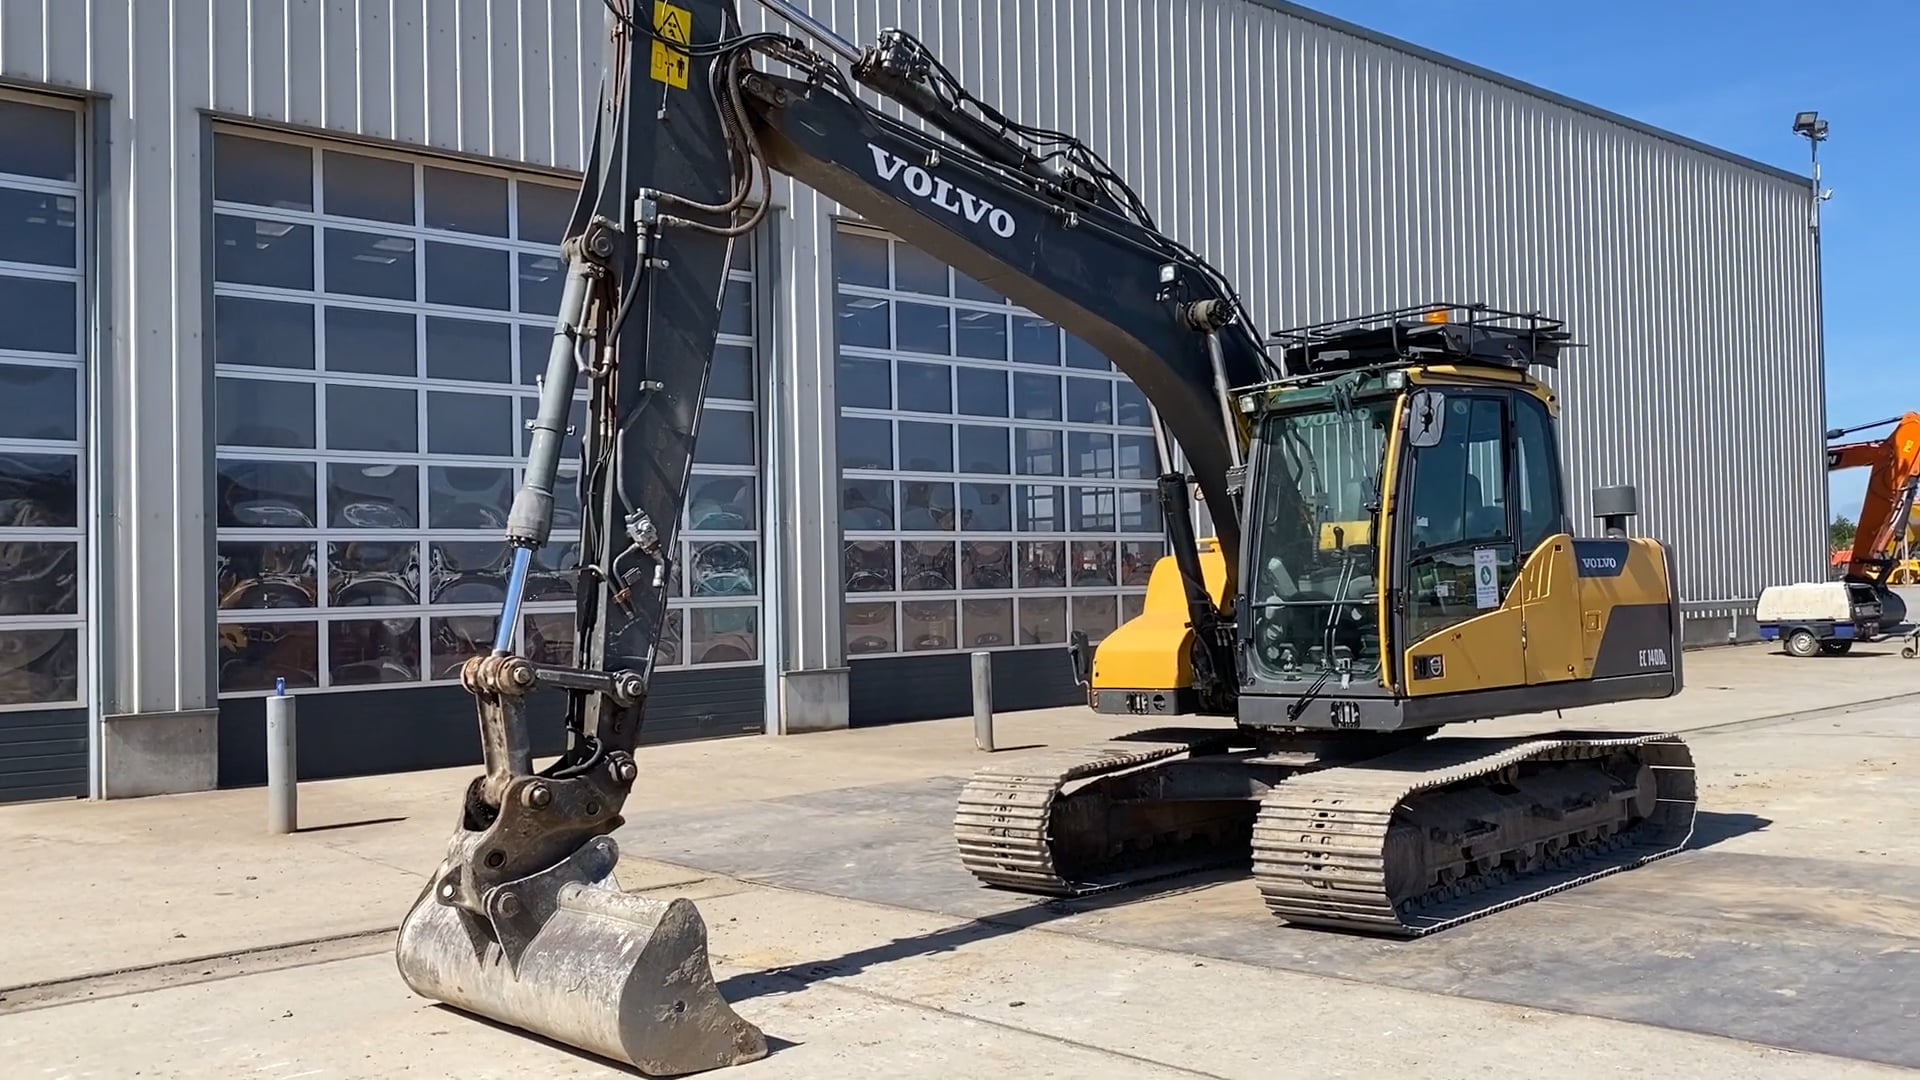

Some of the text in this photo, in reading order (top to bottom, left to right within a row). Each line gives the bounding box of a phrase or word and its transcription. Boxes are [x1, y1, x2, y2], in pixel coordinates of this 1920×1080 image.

[867, 142, 1016, 238] VOLVO
[1294, 407, 1370, 427] VOLO
[1582, 558, 1617, 568] VOLVO
[1639, 650, 1647, 667] EC
